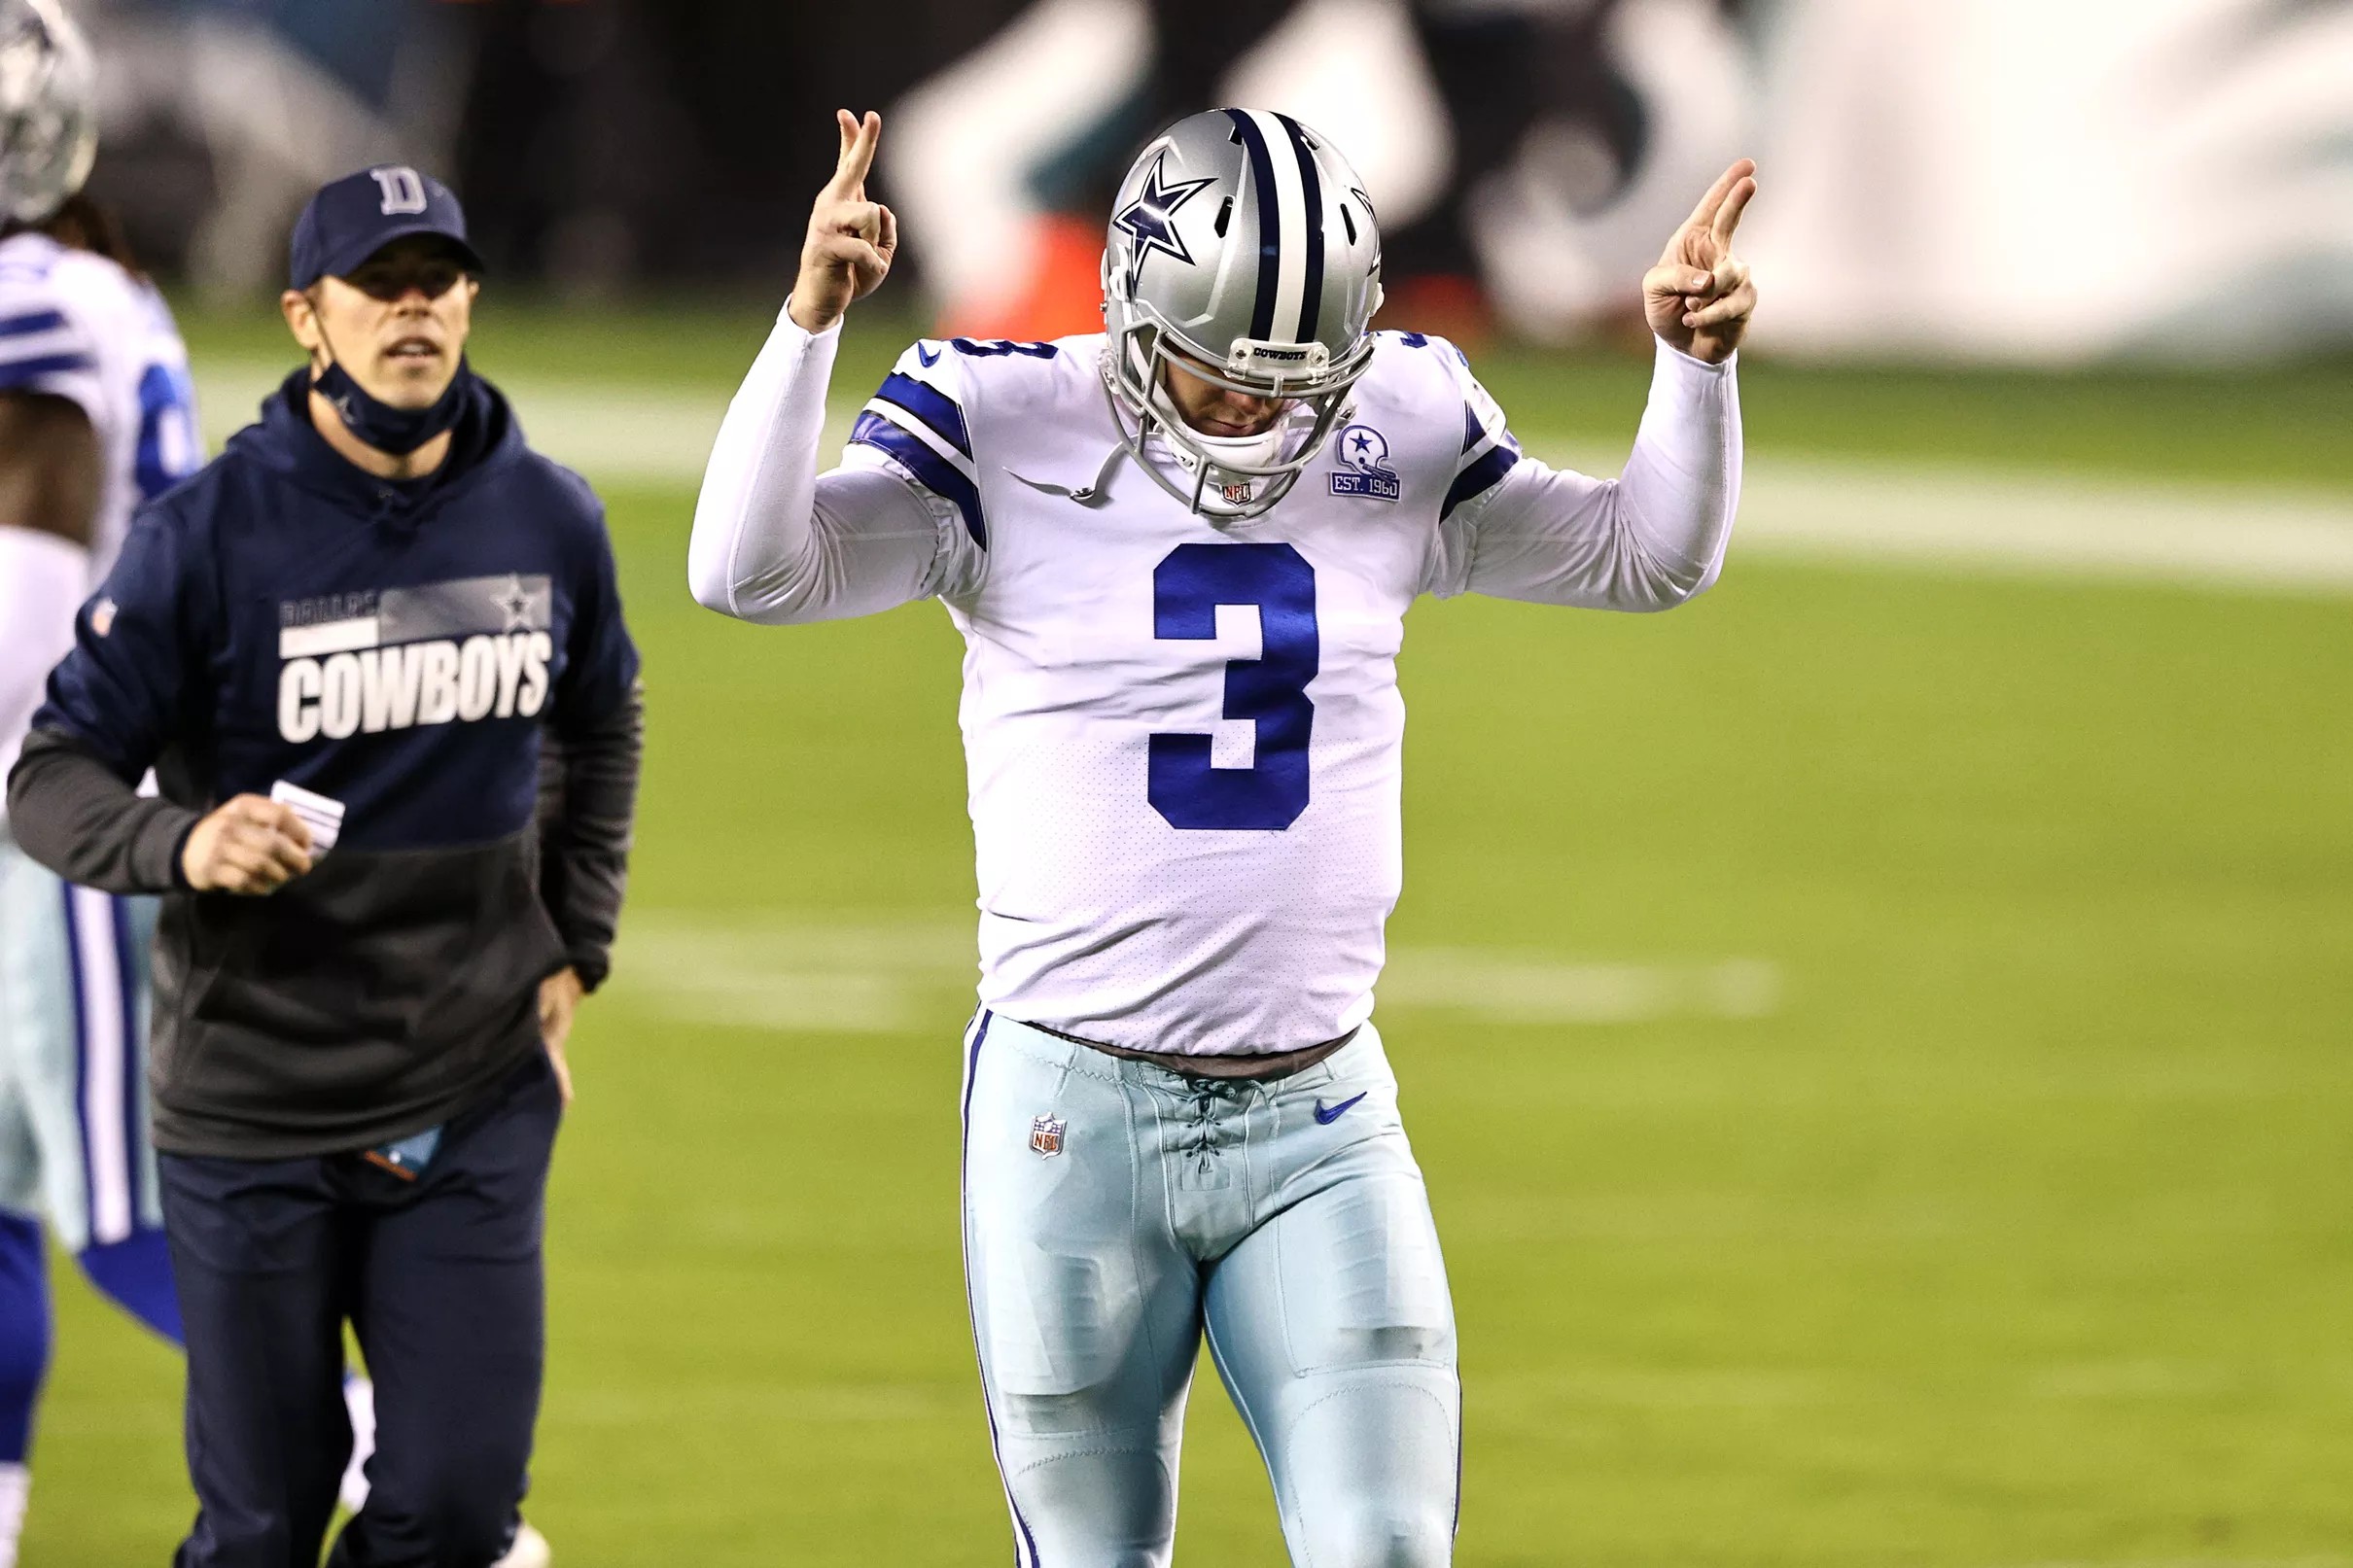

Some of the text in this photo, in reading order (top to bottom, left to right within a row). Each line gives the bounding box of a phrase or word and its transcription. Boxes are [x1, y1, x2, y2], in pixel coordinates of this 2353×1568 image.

[370, 167, 427, 215] D
[1252, 347, 1307, 361] COWBOYS
[1334, 475, 1397, 497] EST. 1960
[277, 631, 552, 744] COWBOYS
[1147, 542, 1319, 831] 3
[1035, 1132, 1058, 1150] NFL
